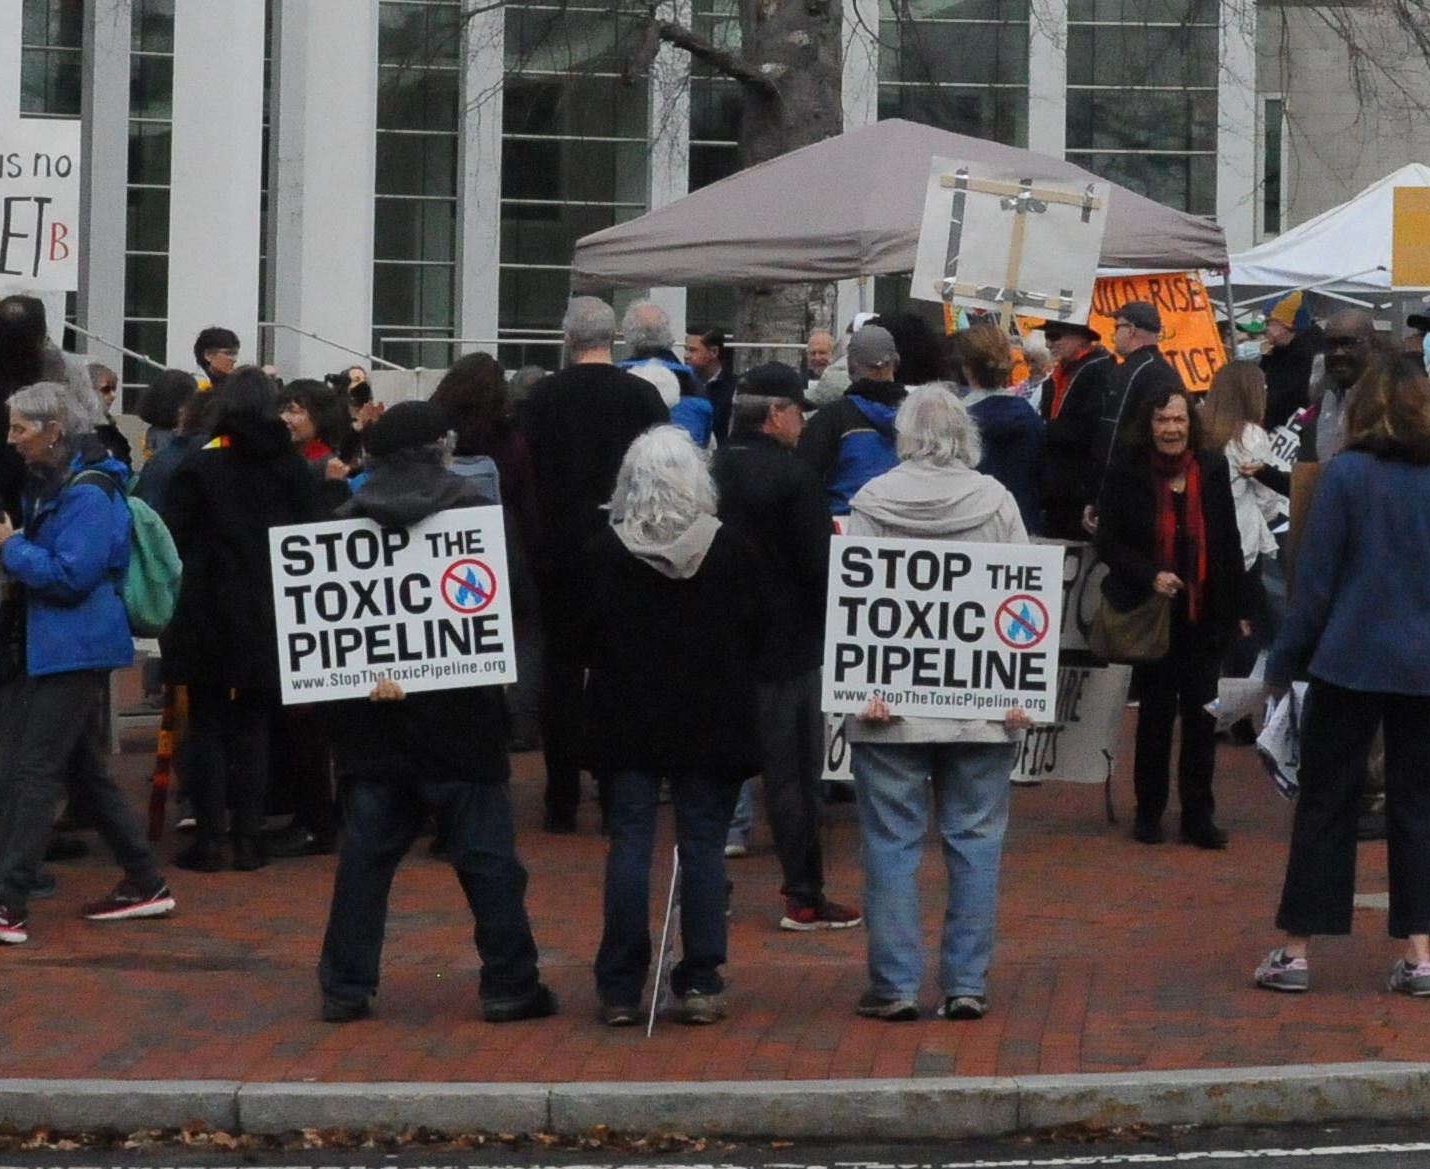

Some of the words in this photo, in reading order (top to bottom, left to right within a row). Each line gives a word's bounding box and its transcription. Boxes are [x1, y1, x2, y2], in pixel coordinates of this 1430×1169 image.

[33, 152, 72, 179] no
[49, 221, 70, 261] B
[280, 527, 410, 577] STOP
[424, 529, 485, 558] THE
[840, 545, 972, 592] STOP
[986, 563, 1043, 591] THE
[284, 572, 433, 625] TOXIC
[838, 596, 986, 643] TOXIC
[288, 613, 504, 673] PIPELINE
[834, 643, 1047, 692] PIPELINE
